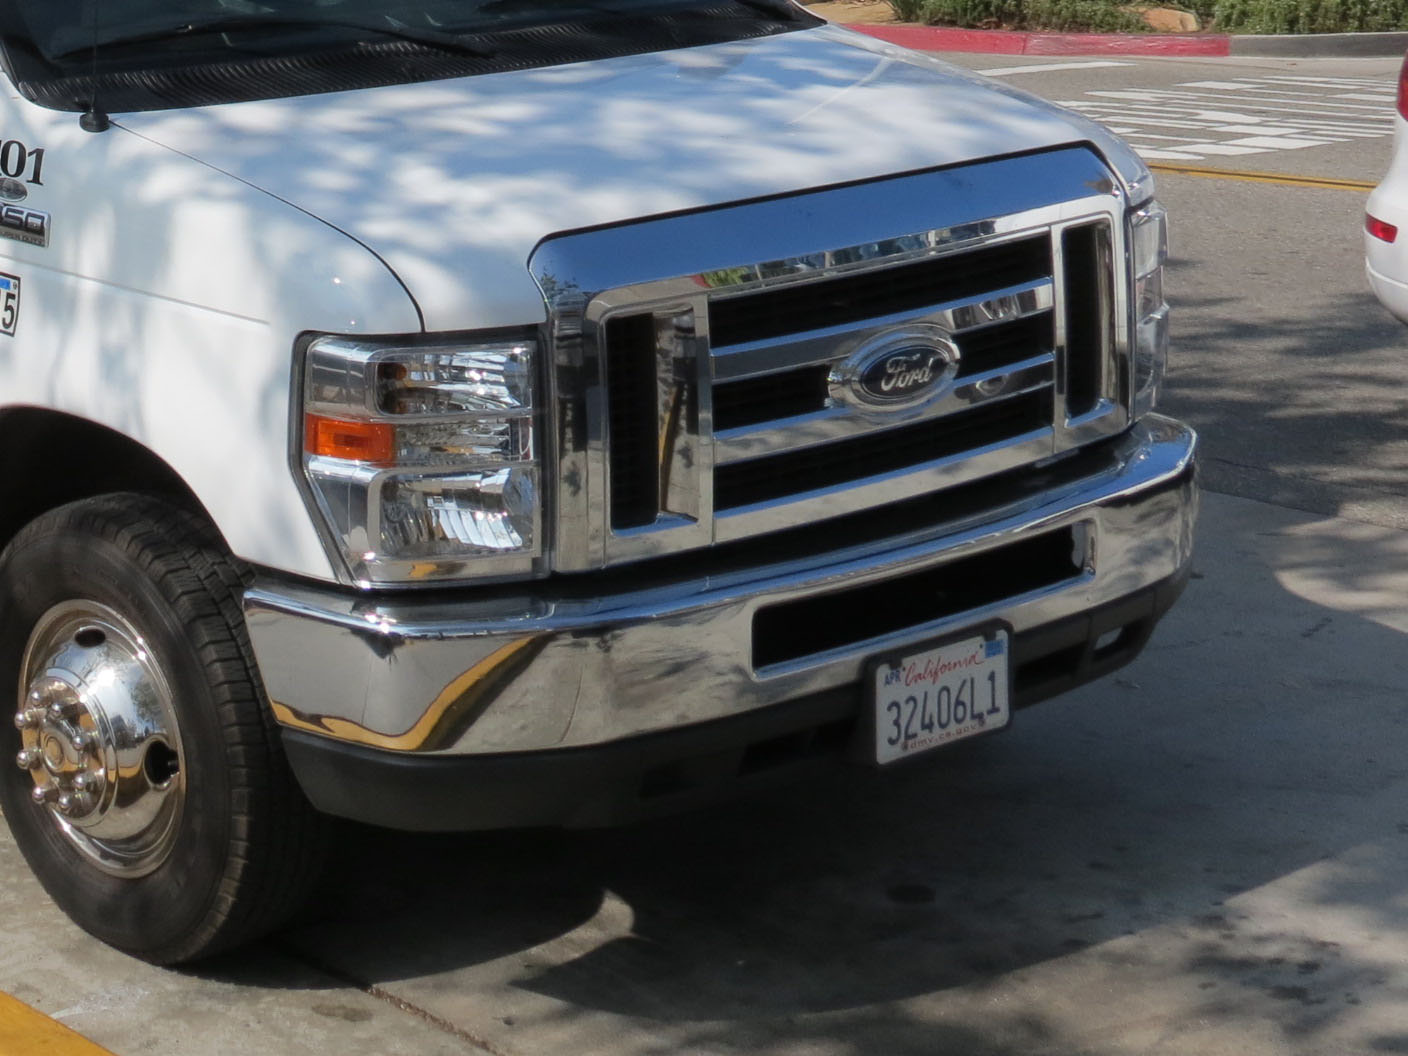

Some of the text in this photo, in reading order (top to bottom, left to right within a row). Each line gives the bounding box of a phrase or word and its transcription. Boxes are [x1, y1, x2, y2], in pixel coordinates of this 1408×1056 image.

[881, 353, 934, 391] Ford
[905, 652, 985, 687] California
[887, 671, 1000, 745] 32406L1
